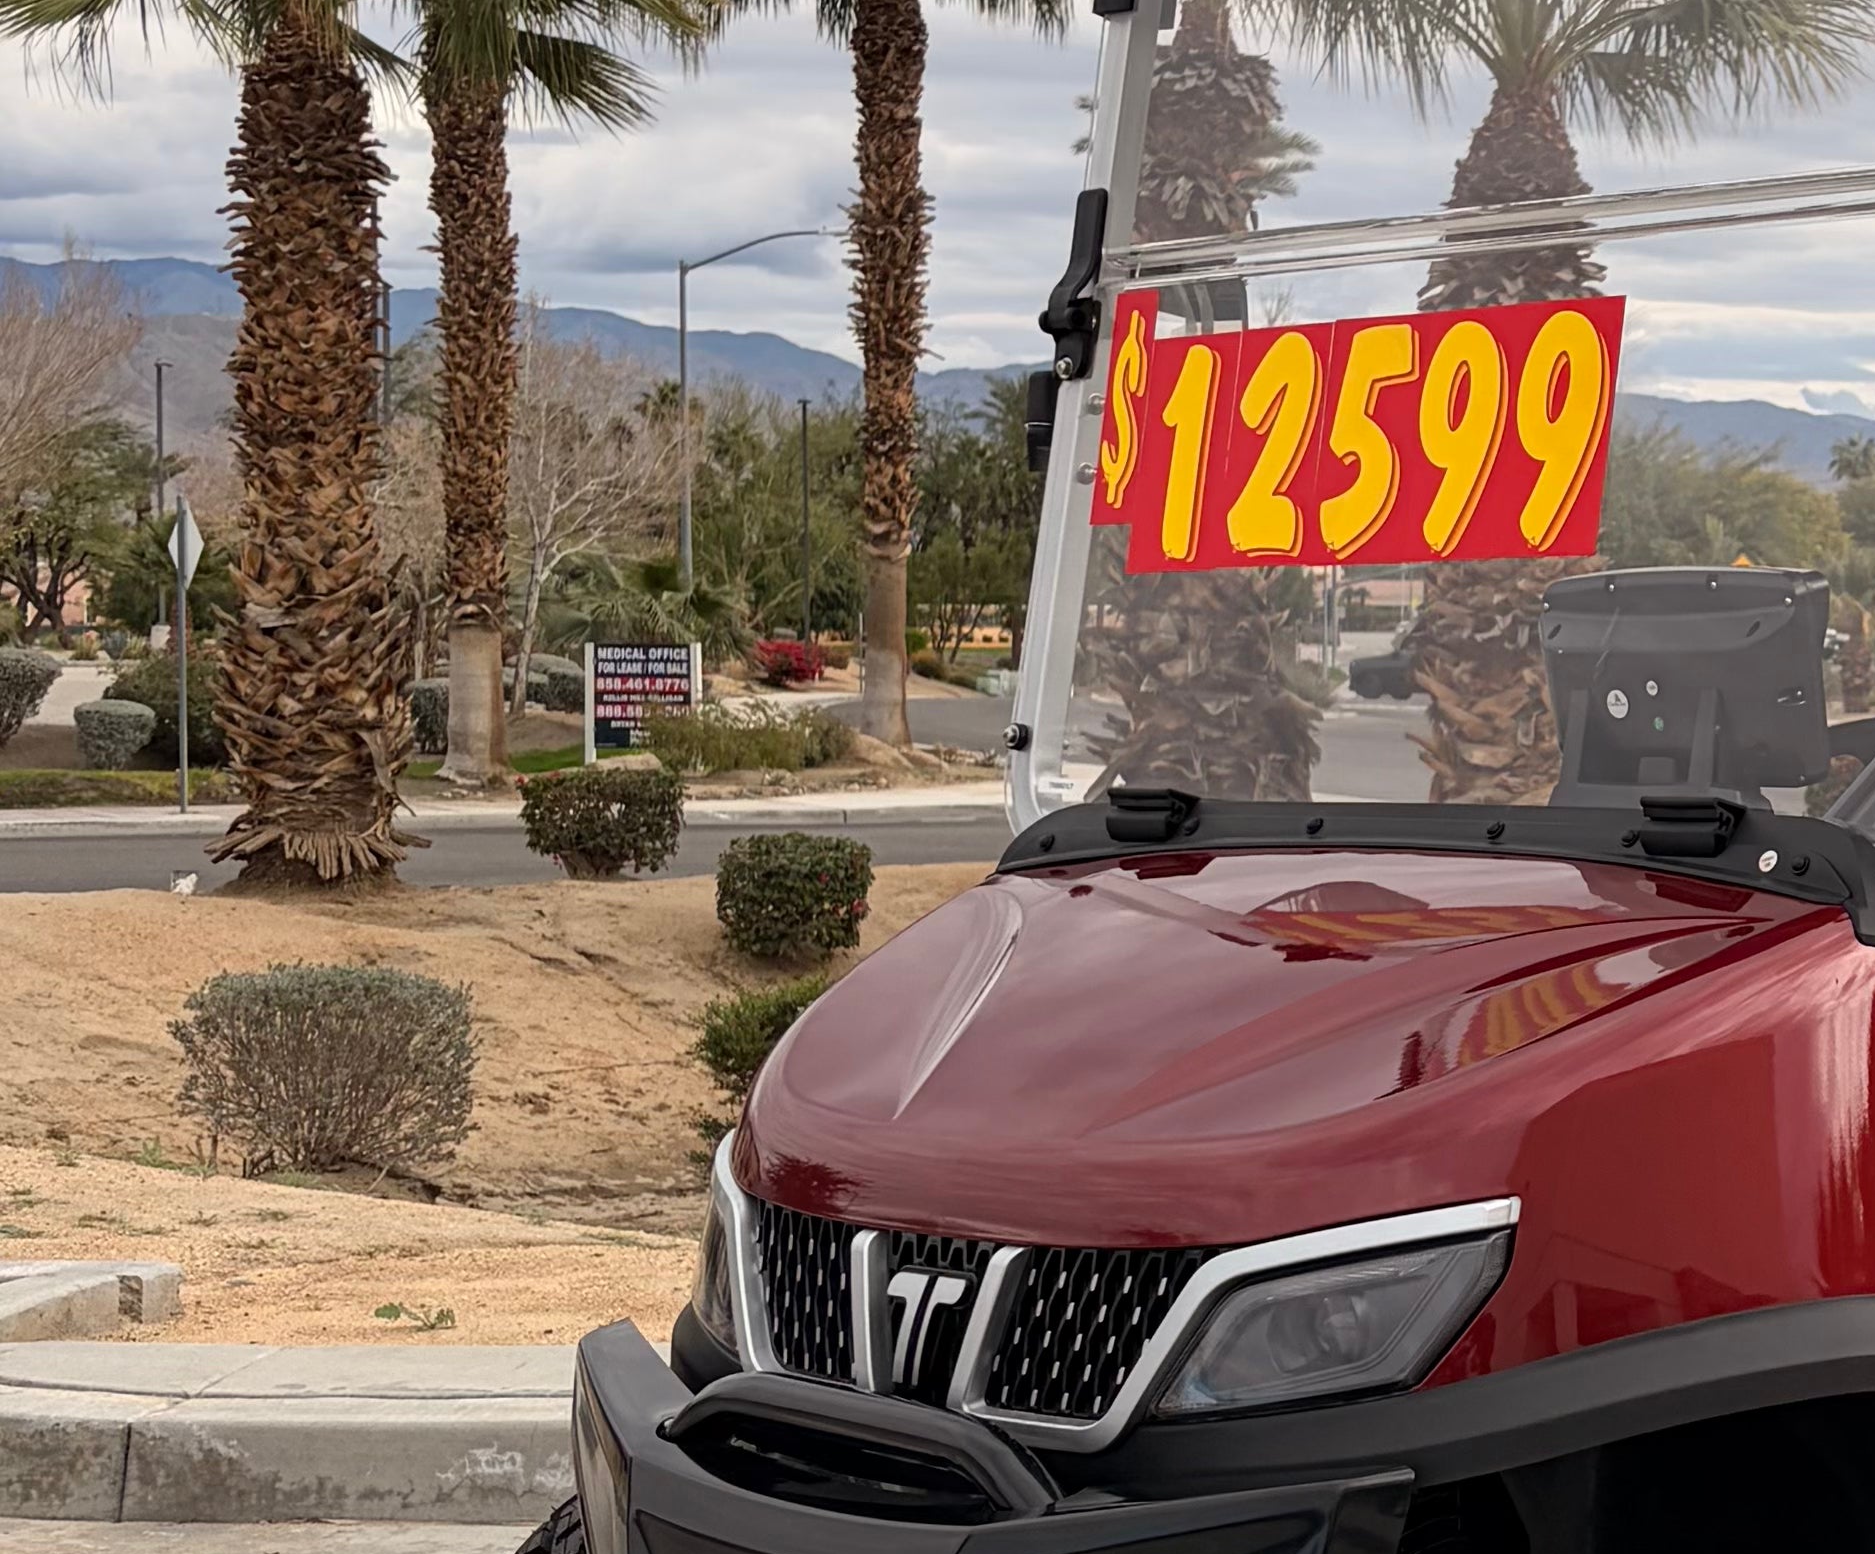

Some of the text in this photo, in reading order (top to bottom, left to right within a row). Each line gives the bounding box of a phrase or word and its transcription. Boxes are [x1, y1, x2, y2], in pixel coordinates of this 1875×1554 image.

[1101, 309, 1611, 560] $12599
[597, 647, 689, 660] MEDICAL OFFICE
[597, 661, 615, 674] FOR
[616, 661, 643, 674] LEASE
[648, 661, 665, 674] FOR
[666, 662, 688, 675] SALE
